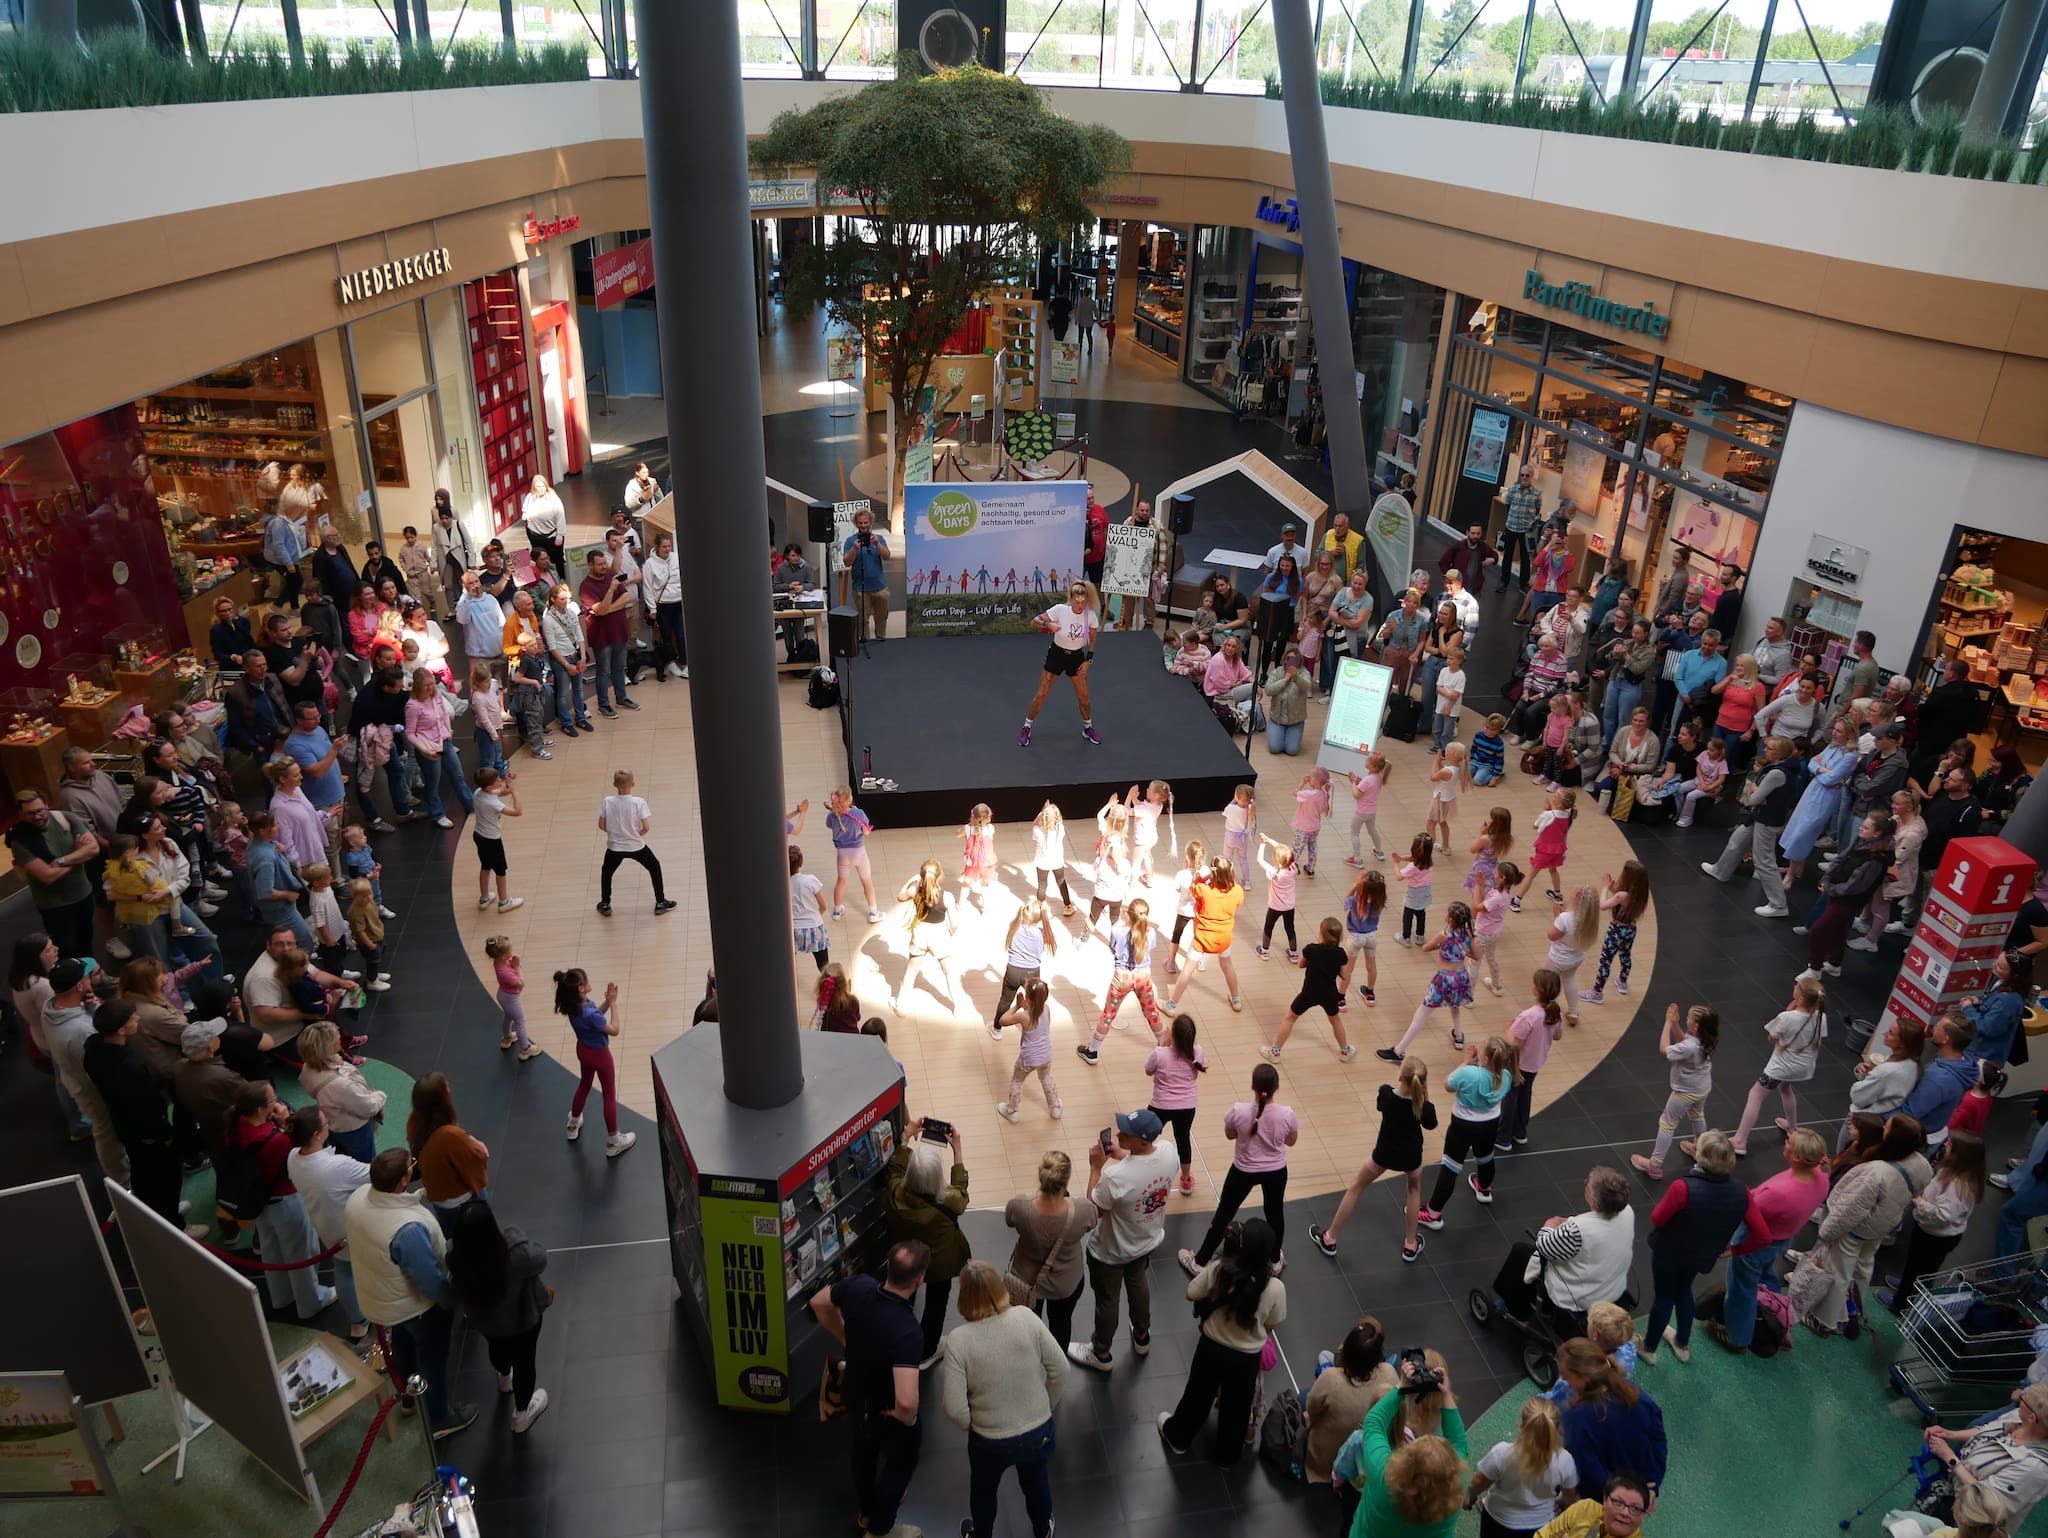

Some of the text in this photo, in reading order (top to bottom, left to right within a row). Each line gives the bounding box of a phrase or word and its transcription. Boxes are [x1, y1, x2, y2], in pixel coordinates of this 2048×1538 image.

[340, 247, 452, 304] NIEDEREGGER
[1523, 268, 1670, 341] Parfümerie
[933, 501, 970, 524] green
[943, 516, 970, 529] DAYS
[981, 510, 1022, 518] nachhaltig,
[1023, 509, 1050, 517] gesund
[981, 518, 1012, 526] achtsam
[1108, 536, 1138, 547] WALD
[1807, 558, 1858, 582] SCHUBACK
[921, 608, 947, 617] Green
[949, 606, 966, 618] Days
[994, 604, 1004, 613] for
[1007, 603, 1022, 613] Life
[808, 1107, 877, 1170] Shoppingcenter
[721, 1242, 764, 1271] NEU
[724, 1269, 766, 1292] HIER
[725, 1290, 768, 1331] IM
[729, 1329, 768, 1356] LUV
